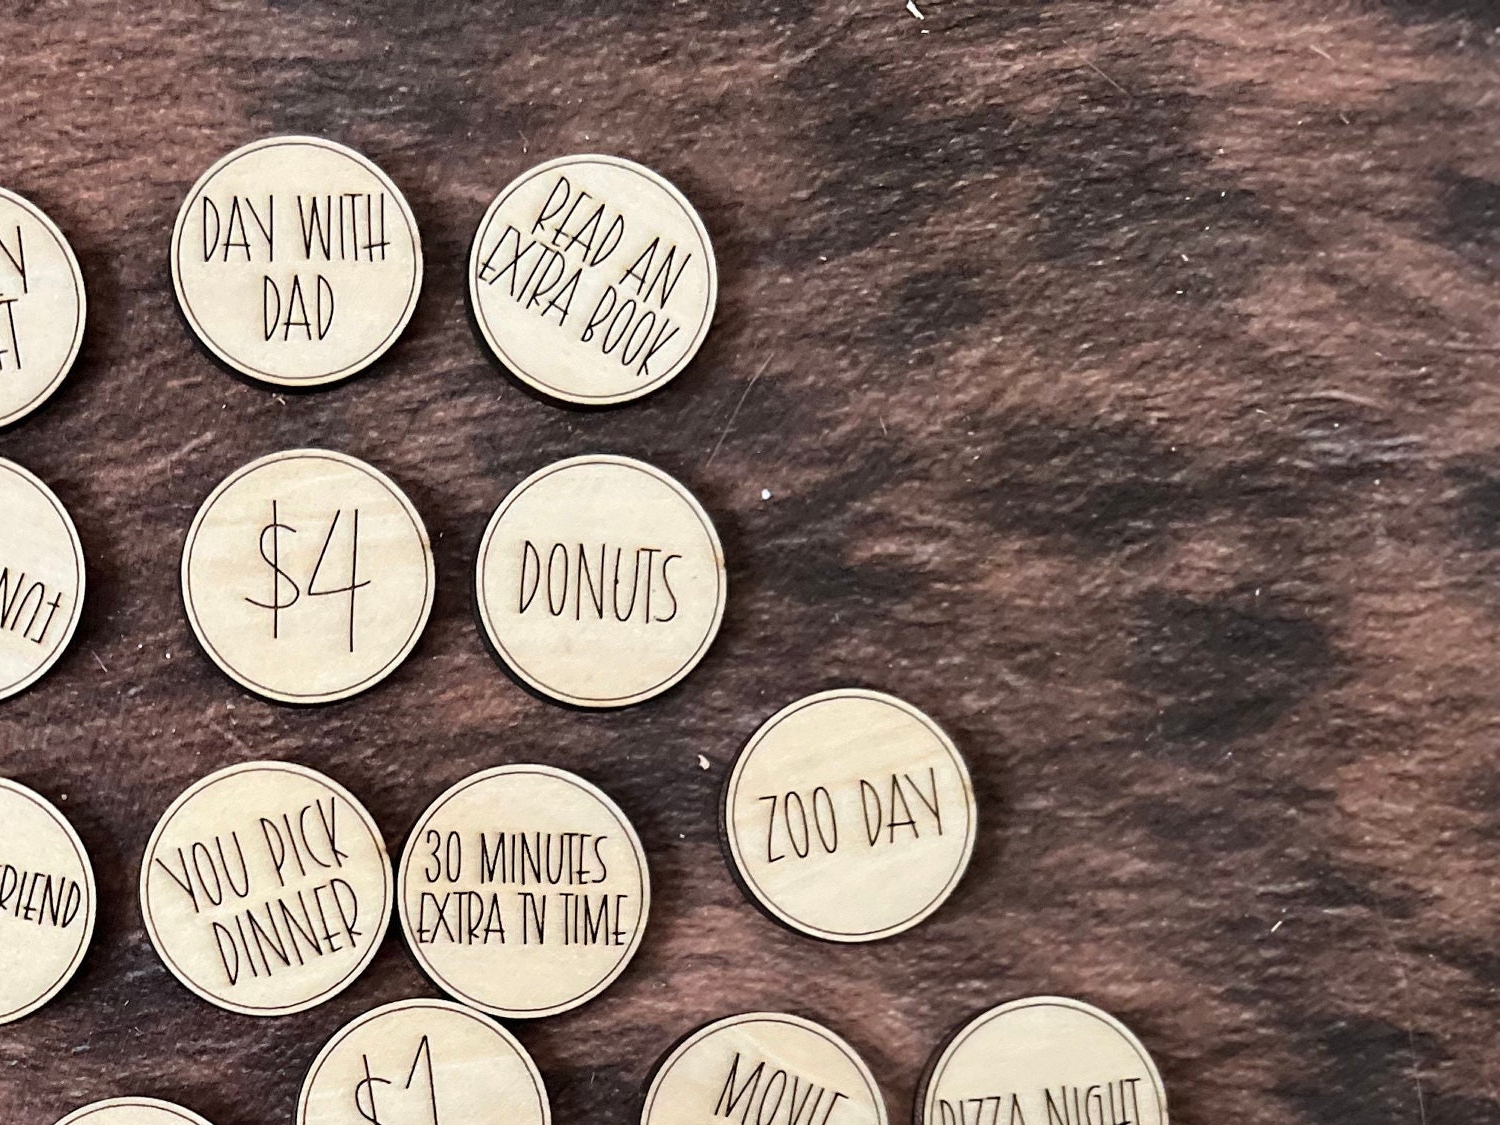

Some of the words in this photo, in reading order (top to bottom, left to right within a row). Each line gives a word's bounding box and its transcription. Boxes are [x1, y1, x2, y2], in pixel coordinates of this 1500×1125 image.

[202, 194, 274, 263] DAY
[296, 192, 391, 263] WITH
[530, 175, 625, 268] READ
[624, 226, 691, 302] AN
[262, 273, 335, 342] DAD
[479, 224, 573, 325] EXTRA
[579, 284, 681, 377] BOOK
[244, 499, 372, 653] $4
[518, 539, 683, 625] DONUTS
[152, 838, 250, 914] YOU
[258, 796, 349, 888] PICK
[424, 829, 462, 884] 30
[480, 831, 608, 886] MINUTES
[758, 786, 838, 864] ZOO
[859, 767, 943, 848] DAY
[211, 877, 363, 987] DINNER
[416, 890, 506, 946] EXTRA
[517, 891, 547, 946] TV
[558, 892, 629, 947] TIME
